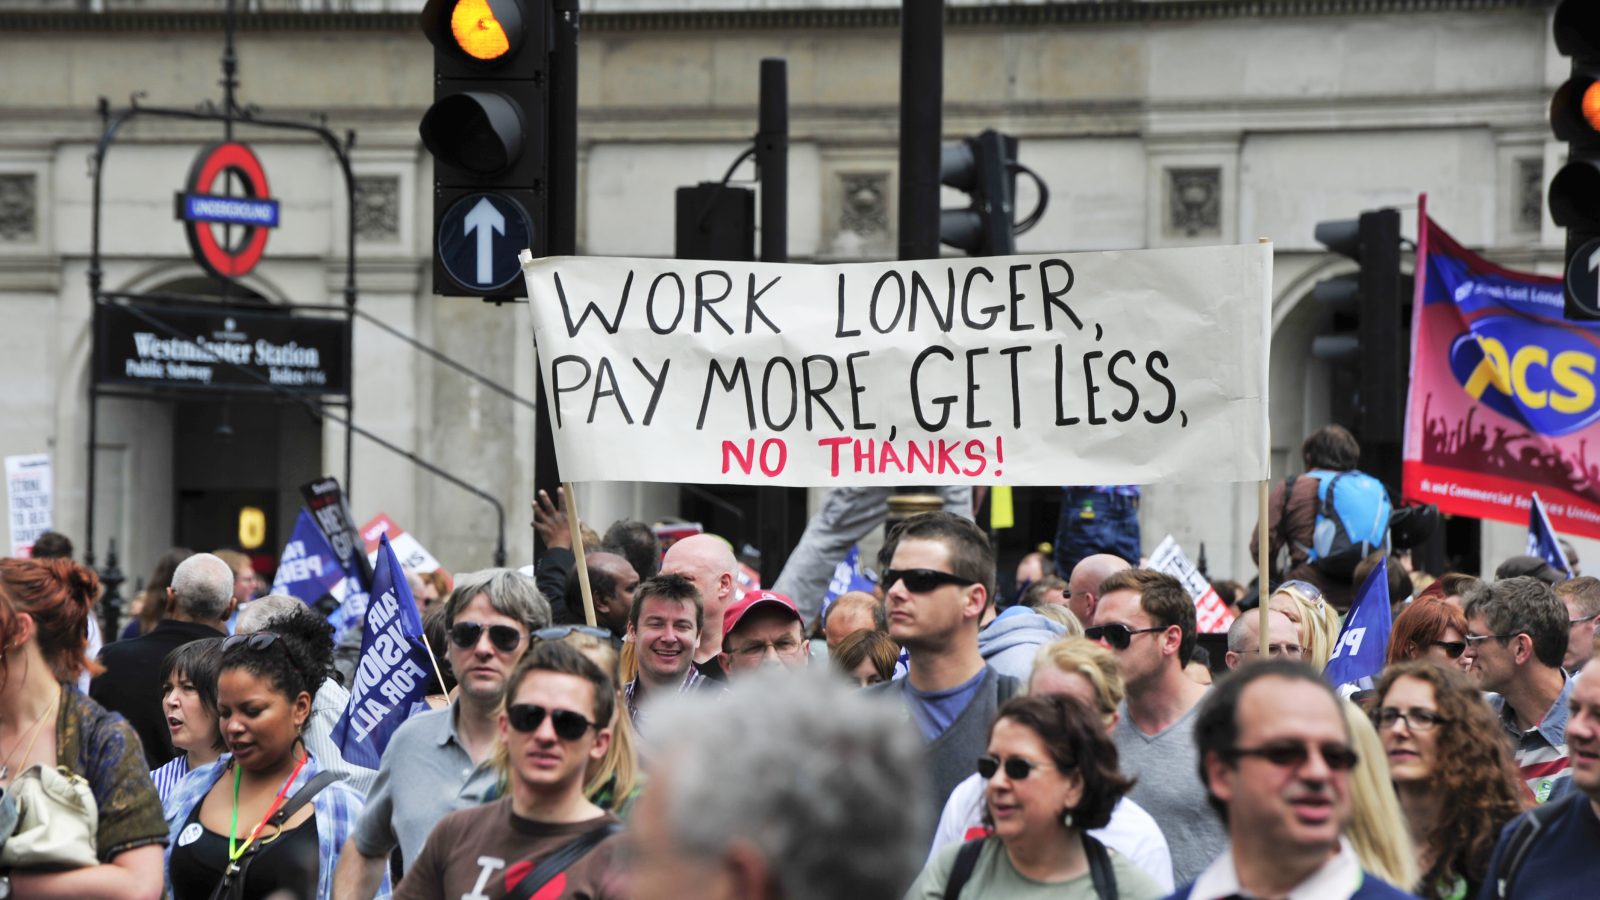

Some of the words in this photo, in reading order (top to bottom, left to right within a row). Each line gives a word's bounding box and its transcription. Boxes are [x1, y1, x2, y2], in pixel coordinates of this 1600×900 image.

[192, 199, 271, 220] UNDERGROUND
[553, 269, 781, 338] WORK
[836, 258, 1103, 343] LONGER,
[1531, 287, 1565, 308] Lond
[133, 332, 253, 364] Westminster
[255, 338, 319, 368] Station
[126, 358, 165, 379] Public
[167, 361, 213, 385] Subway
[552, 354, 671, 430] PAY
[696, 350, 897, 443] MORE,
[910, 344, 1032, 433] GET
[1056, 344, 1189, 428] LESS,
[722, 438, 788, 478] NO
[819, 436, 1005, 478] THANKS!
[1449, 482, 1514, 506] Commercial
[1515, 494, 1564, 518] Serces
